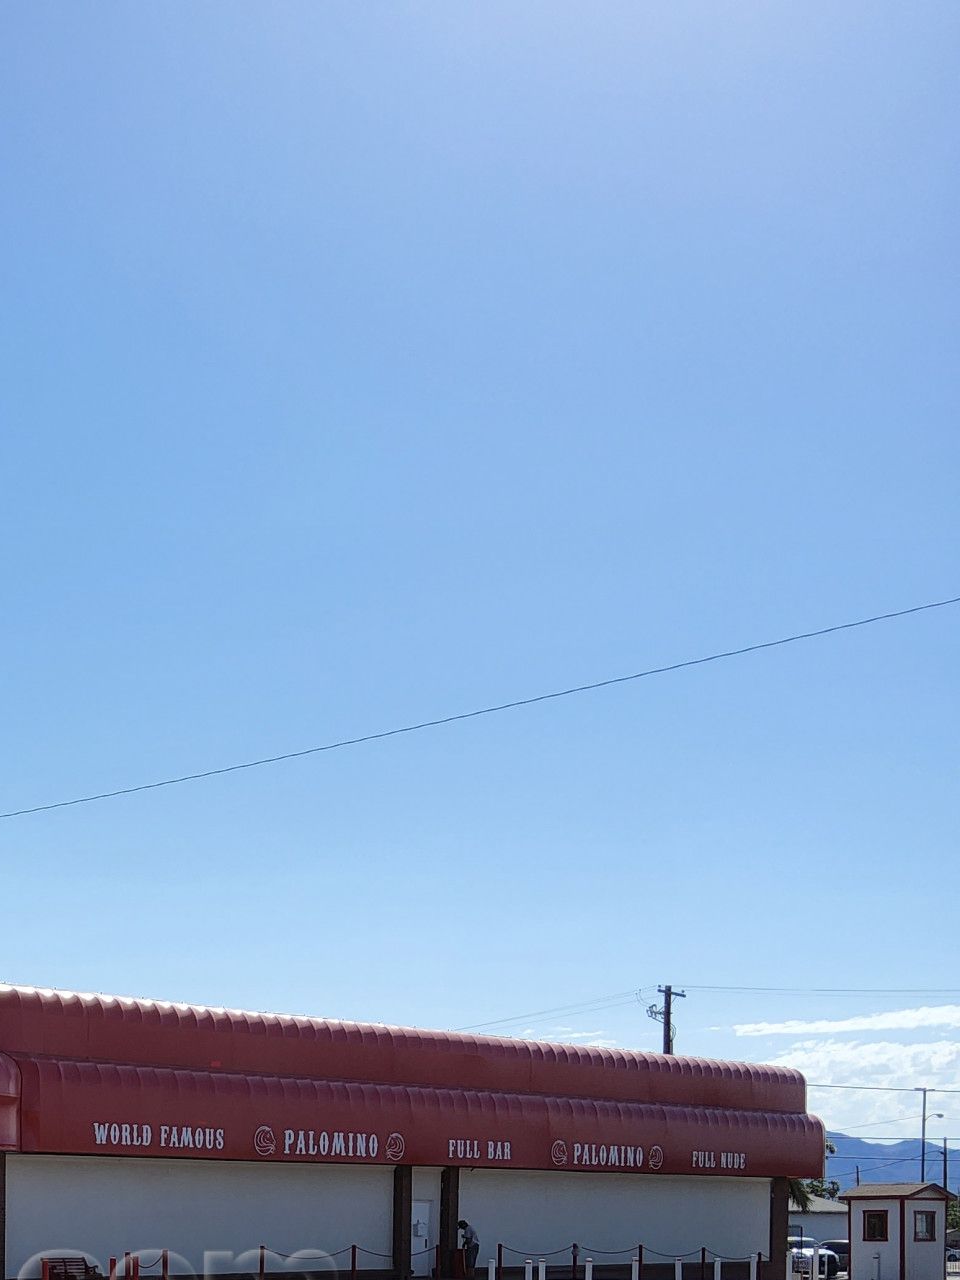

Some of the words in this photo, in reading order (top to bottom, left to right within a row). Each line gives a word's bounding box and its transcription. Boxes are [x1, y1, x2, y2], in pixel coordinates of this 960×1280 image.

[93, 1122, 152, 1146] WORLD
[160, 1125, 224, 1149] FAMOUS
[283, 1129, 378, 1158] PALOMINO
[448, 1139, 480, 1159] FULL
[487, 1141, 512, 1160] BAR
[573, 1143, 644, 1167] PALOMINO
[692, 1151, 716, 1168] FULL
[720, 1152, 746, 1169] NUDE
